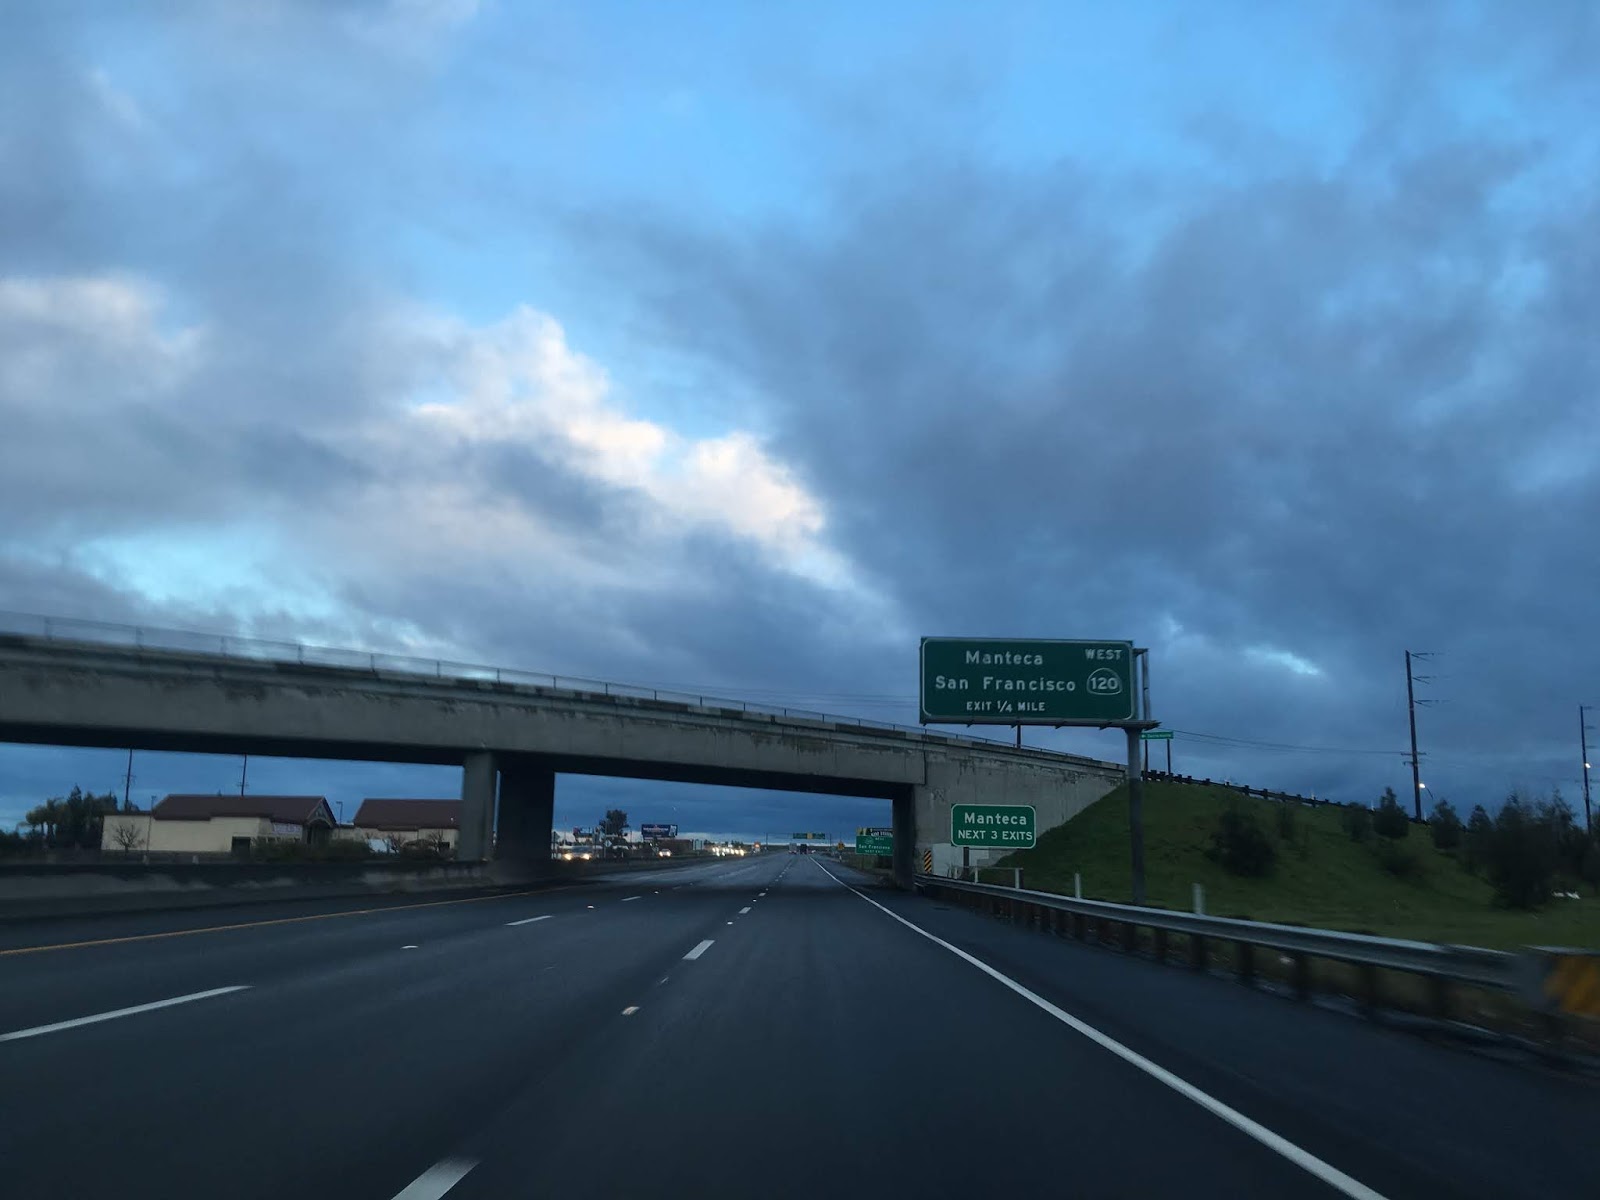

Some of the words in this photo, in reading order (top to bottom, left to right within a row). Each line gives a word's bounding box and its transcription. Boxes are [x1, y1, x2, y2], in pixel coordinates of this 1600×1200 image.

[966, 650, 1044, 666] Manteca
[1084, 648, 1123, 660] WEST
[935, 676, 969, 690] San
[983, 676, 1076, 692] Francisco
[1090, 677, 1119, 690] 120
[966, 701, 992, 711] EXIT
[1018, 702, 1046, 712] MILE
[964, 812, 1028, 826] Manteca
[958, 830, 987, 840] NEXT
[991, 831, 998, 840] 3
[1002, 830, 1033, 841] EXITS
